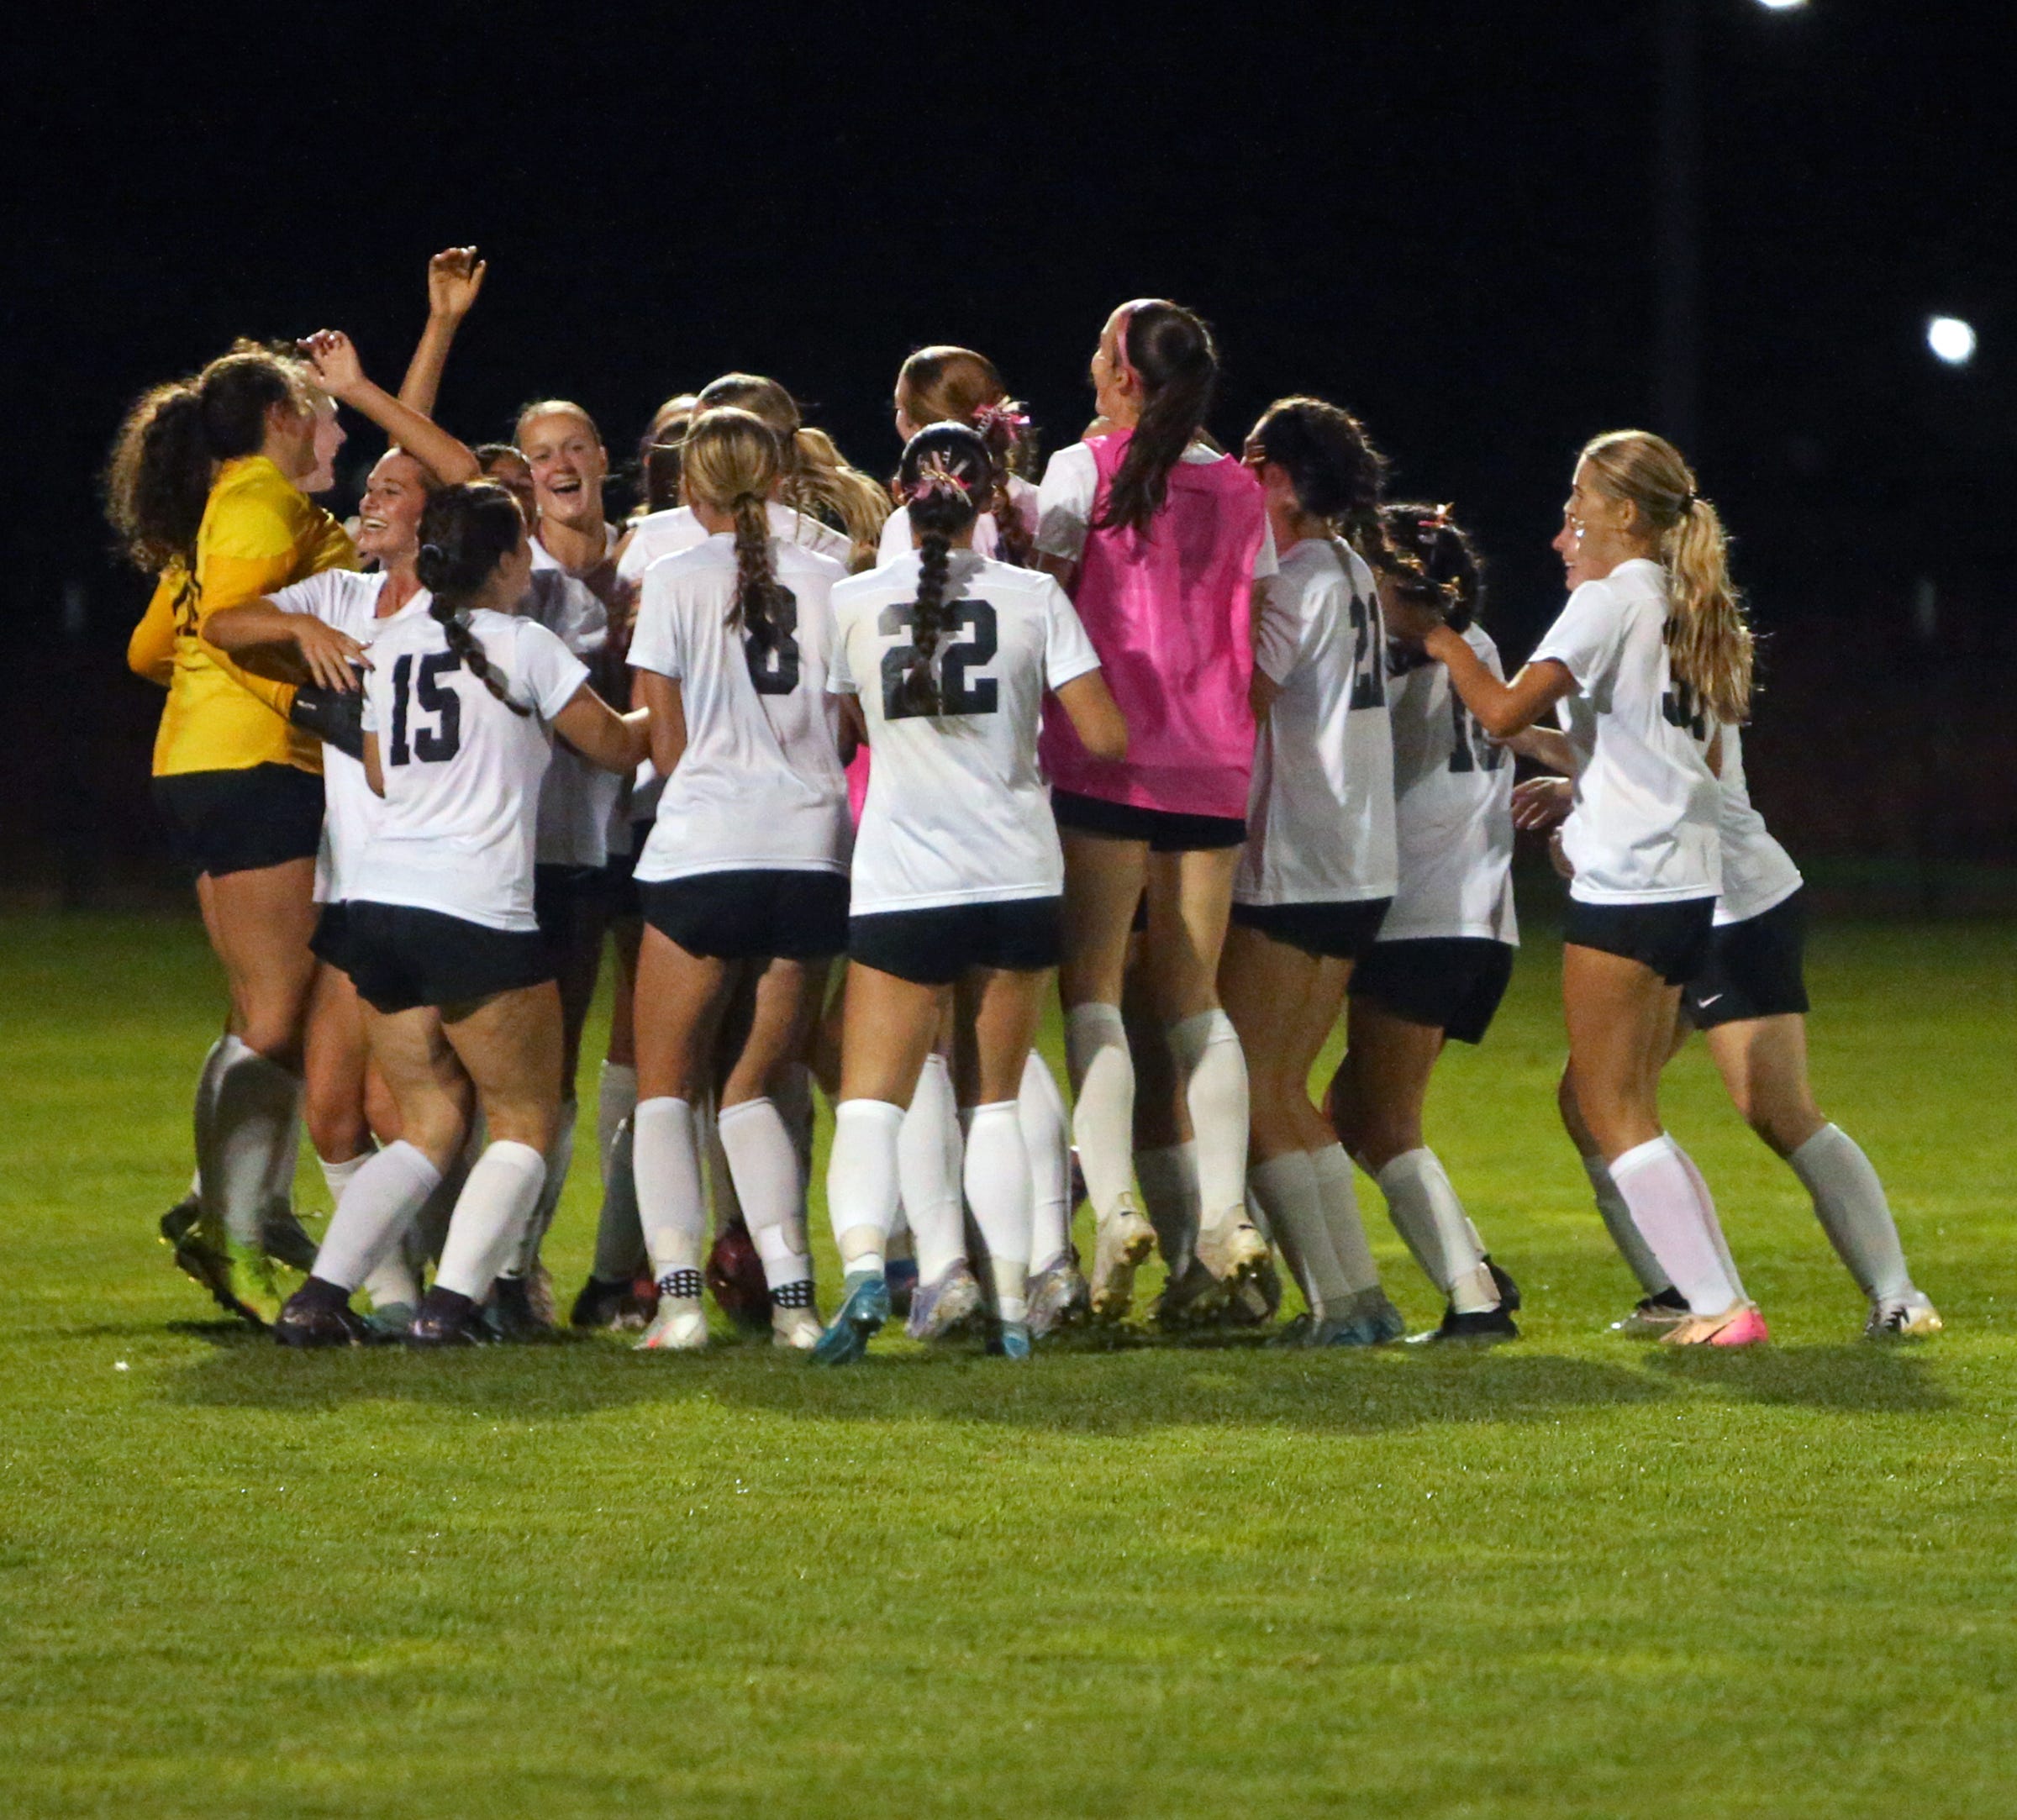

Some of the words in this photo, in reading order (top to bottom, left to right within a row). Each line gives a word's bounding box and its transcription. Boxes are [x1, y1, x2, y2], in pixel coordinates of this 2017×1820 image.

[745, 584, 800, 695] 8
[878, 599, 998, 720] 22
[1349, 592, 1386, 709] 21
[390, 651, 461, 766] 15
[1447, 679, 1504, 772] 1
